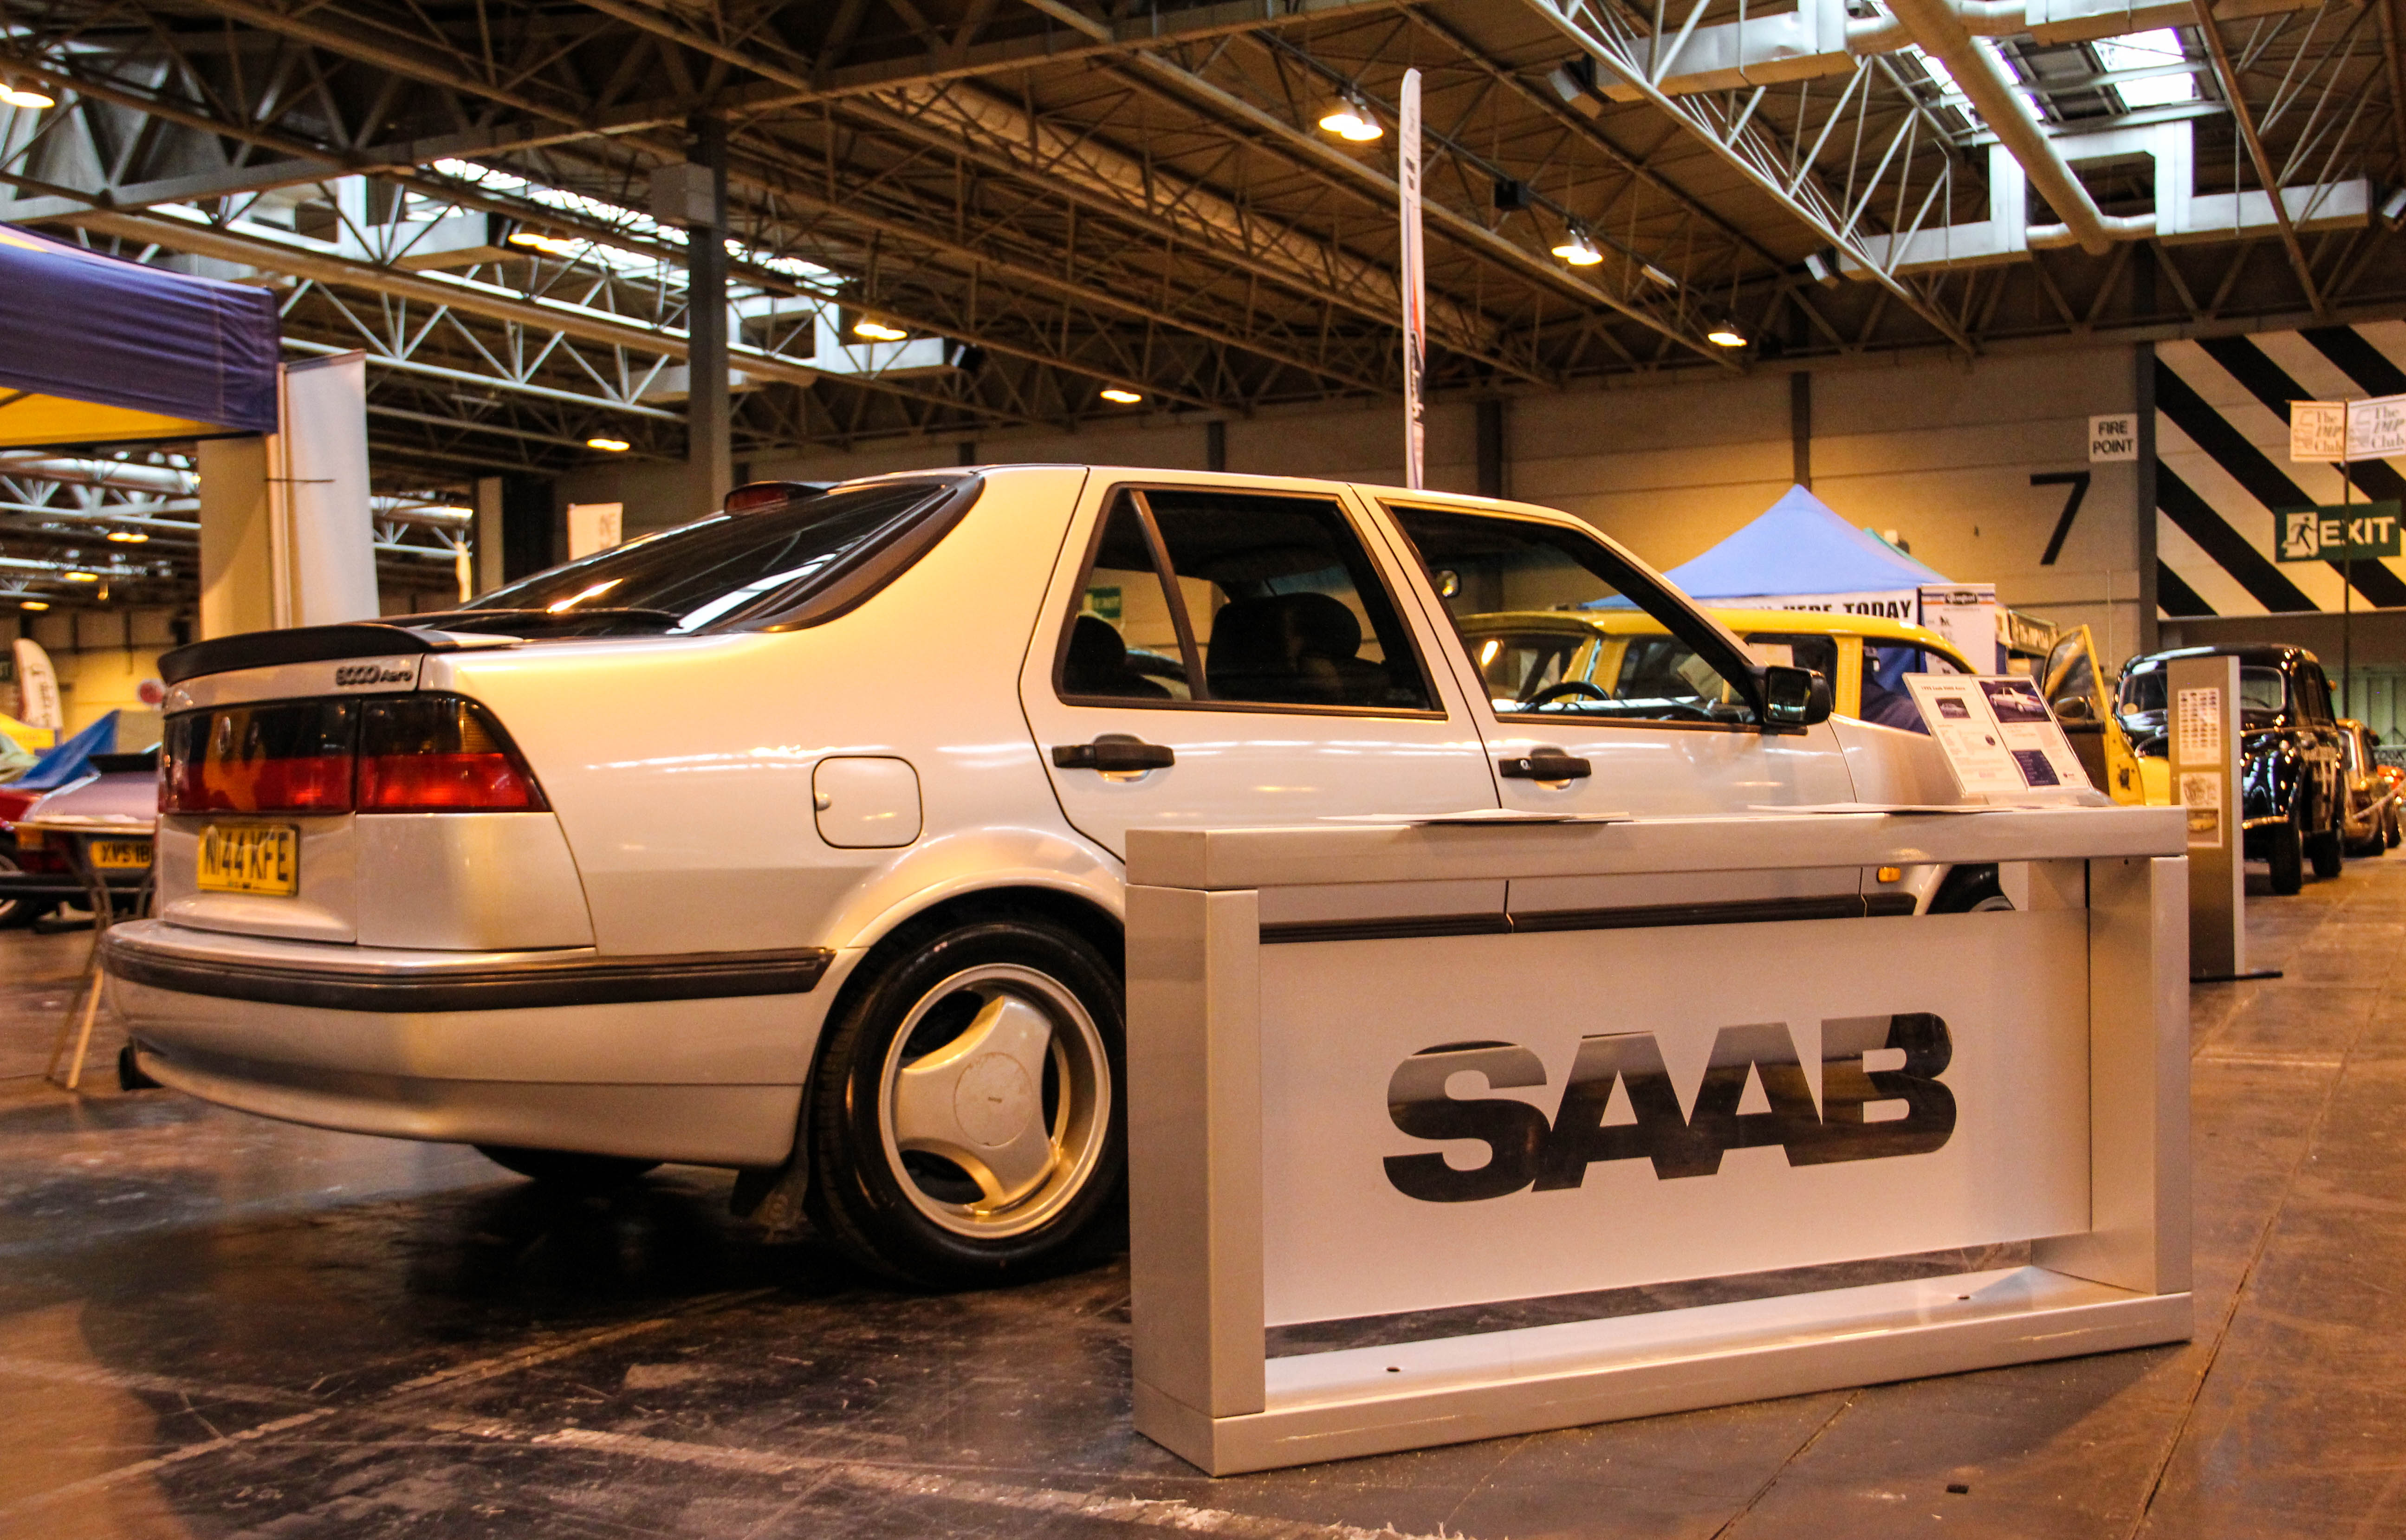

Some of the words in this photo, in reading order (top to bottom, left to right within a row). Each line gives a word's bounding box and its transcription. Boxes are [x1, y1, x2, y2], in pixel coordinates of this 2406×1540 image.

[2373, 405, 2400, 420] The
[2098, 420, 2128, 435] FIRE
[2093, 438, 2134, 453] POINT
[2030, 471, 2091, 566] 7
[2320, 516, 2396, 548] EXIT
[1843, 600, 1912, 619] TODAY
[1383, 1011, 1957, 1203] SAAB
